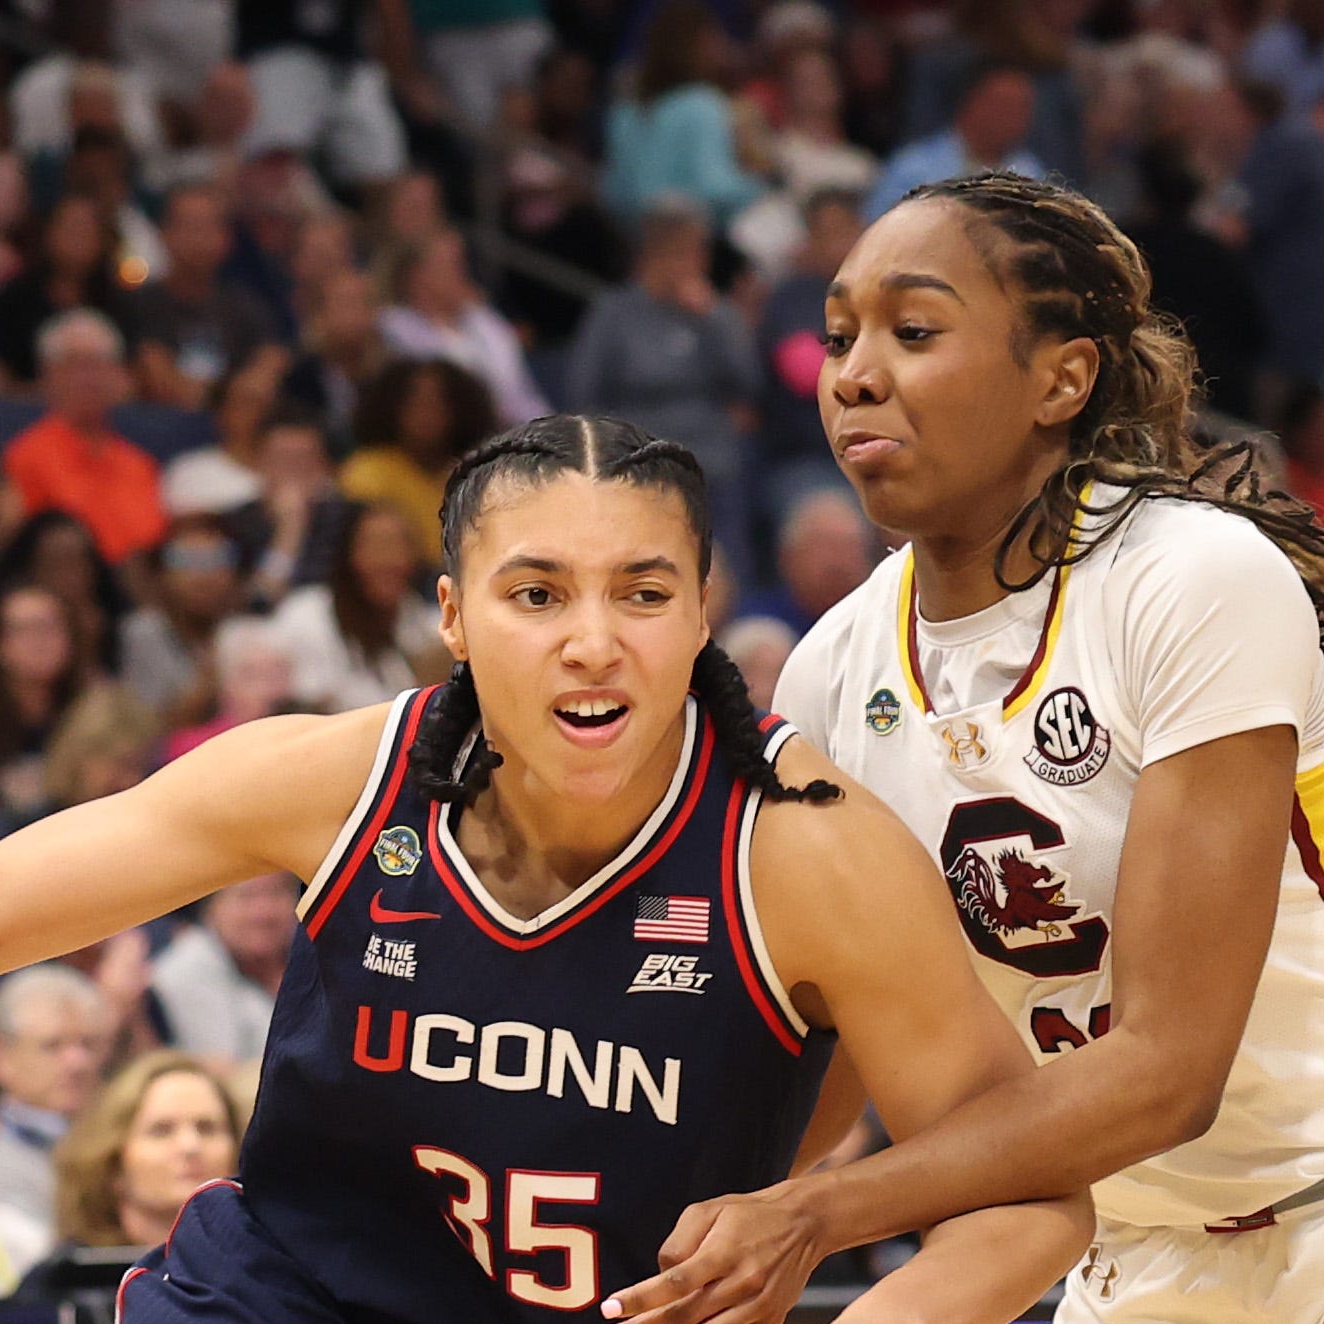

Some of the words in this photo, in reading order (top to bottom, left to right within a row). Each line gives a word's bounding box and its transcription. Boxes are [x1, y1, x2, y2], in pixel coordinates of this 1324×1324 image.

[1038, 692, 1091, 760] SEC
[1038, 744, 1106, 784] GRADUATE
[384, 941, 416, 961] THE
[641, 953, 699, 972] BIG
[632, 969, 713, 988] EAST
[352, 1005, 681, 1126] UCONN
